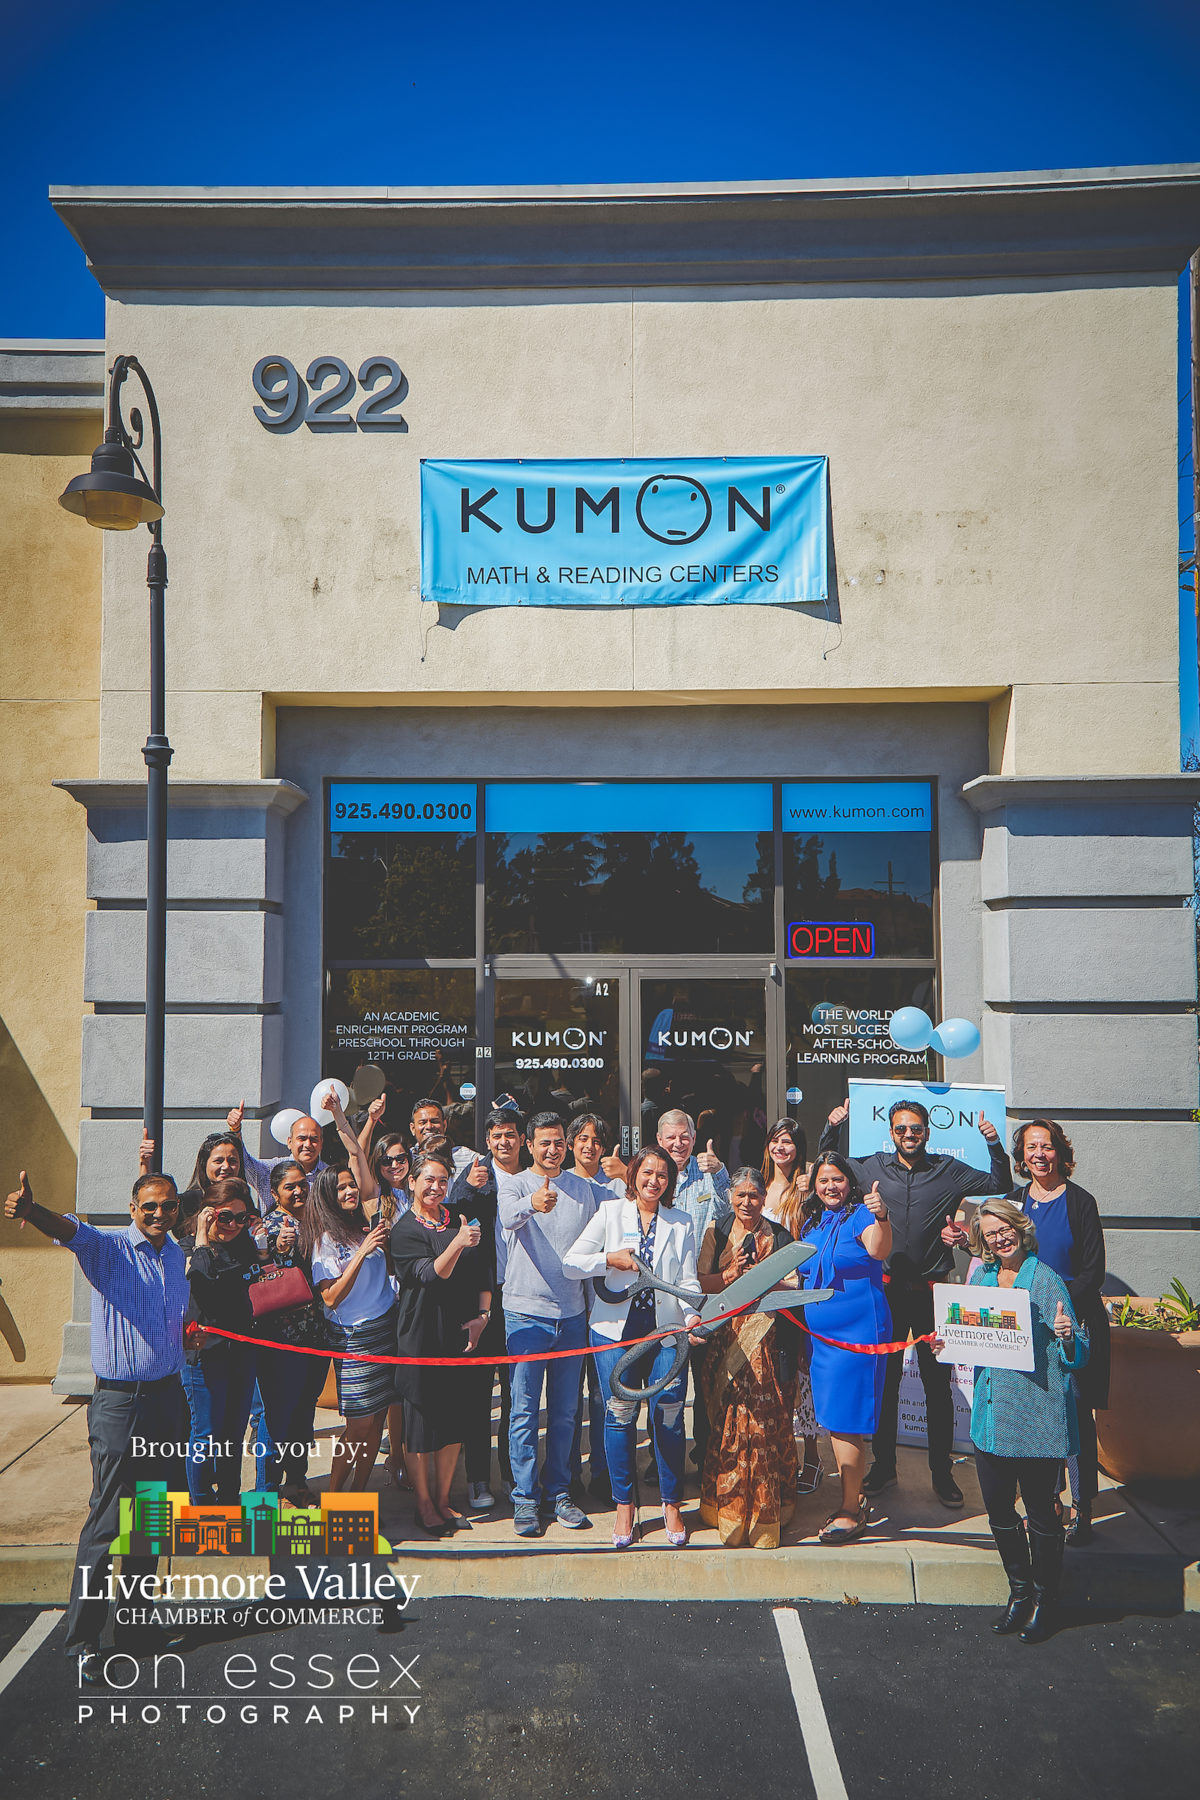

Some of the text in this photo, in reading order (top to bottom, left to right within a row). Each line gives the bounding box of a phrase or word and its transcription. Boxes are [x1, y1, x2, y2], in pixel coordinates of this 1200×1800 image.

[252, 355, 409, 434] 922
[466, 564, 779, 585] MATH & READING CENTERS
[334, 802, 473, 820] 925.490.0300
[789, 805, 925, 818] www.kumon.com
[791, 926, 872, 955] OPEN
[363, 1011, 440, 1022] AN ACADEMIC
[818, 1009, 843, 1020] THE
[336, 1024, 468, 1035] ENRICHMENT PROGRAM
[802, 1024, 890, 1036] MOST SUCCES
[338, 1037, 465, 1048] PRESCHOOL THROUGH
[367, 1051, 436, 1061] 12TH GRADE
[796, 1053, 927, 1065] LEARNING PROGRAM
[515, 1058, 604, 1069] 925.490.0300
[872, 1105, 974, 1130] KON
[938, 1325, 1030, 1347] Livermore Valley
[947, 1338, 978, 1347] CHAMBER
[984, 1341, 1021, 1351] COMMERCE
